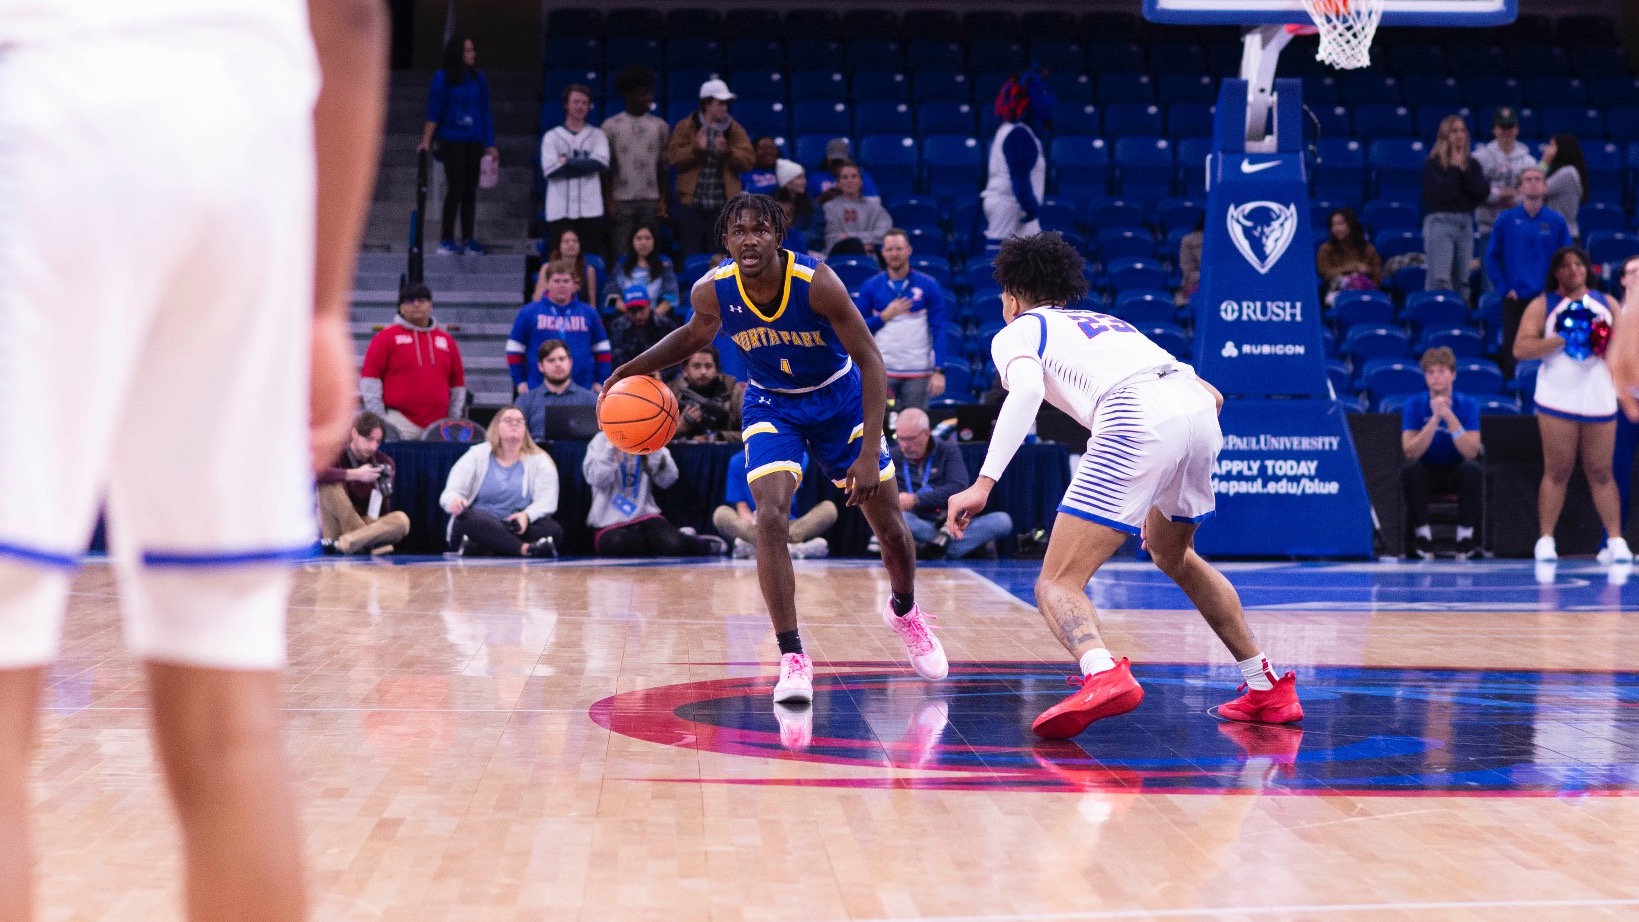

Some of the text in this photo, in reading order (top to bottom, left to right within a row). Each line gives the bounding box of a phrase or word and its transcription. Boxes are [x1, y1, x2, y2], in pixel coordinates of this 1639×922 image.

[1241, 301, 1303, 321] RUSH
[778, 330, 828, 347] PARK
[1241, 344, 1305, 355] RUBICON
[1260, 434, 1340, 451] UNIVERSITY
[1212, 459, 1319, 476] APPLY TODAY
[1211, 478, 1340, 496] depaul.edu/blue
